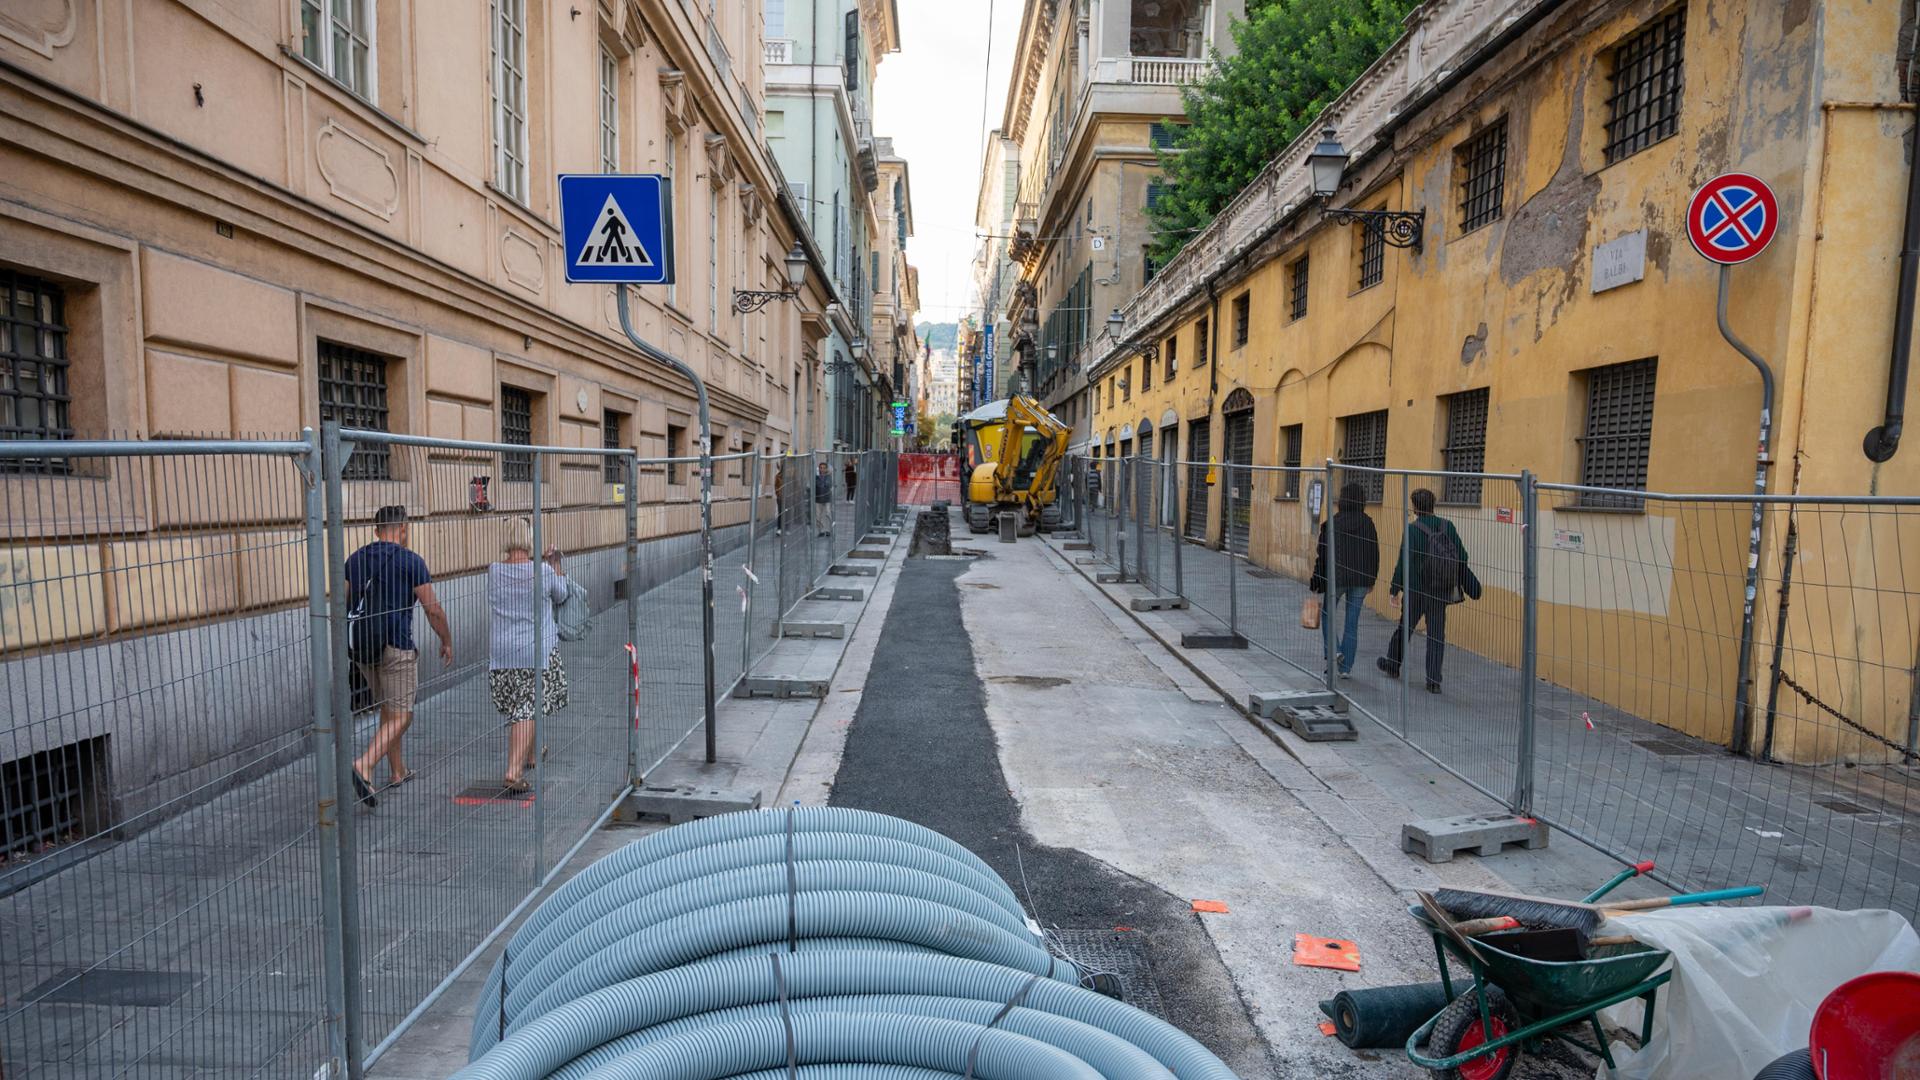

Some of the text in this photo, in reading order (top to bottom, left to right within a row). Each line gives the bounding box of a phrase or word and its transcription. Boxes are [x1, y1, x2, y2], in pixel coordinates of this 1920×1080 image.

[1610, 248, 1623, 260] VIA
[1604, 262, 1626, 280] BALBI
[985, 360, 992, 368] di
